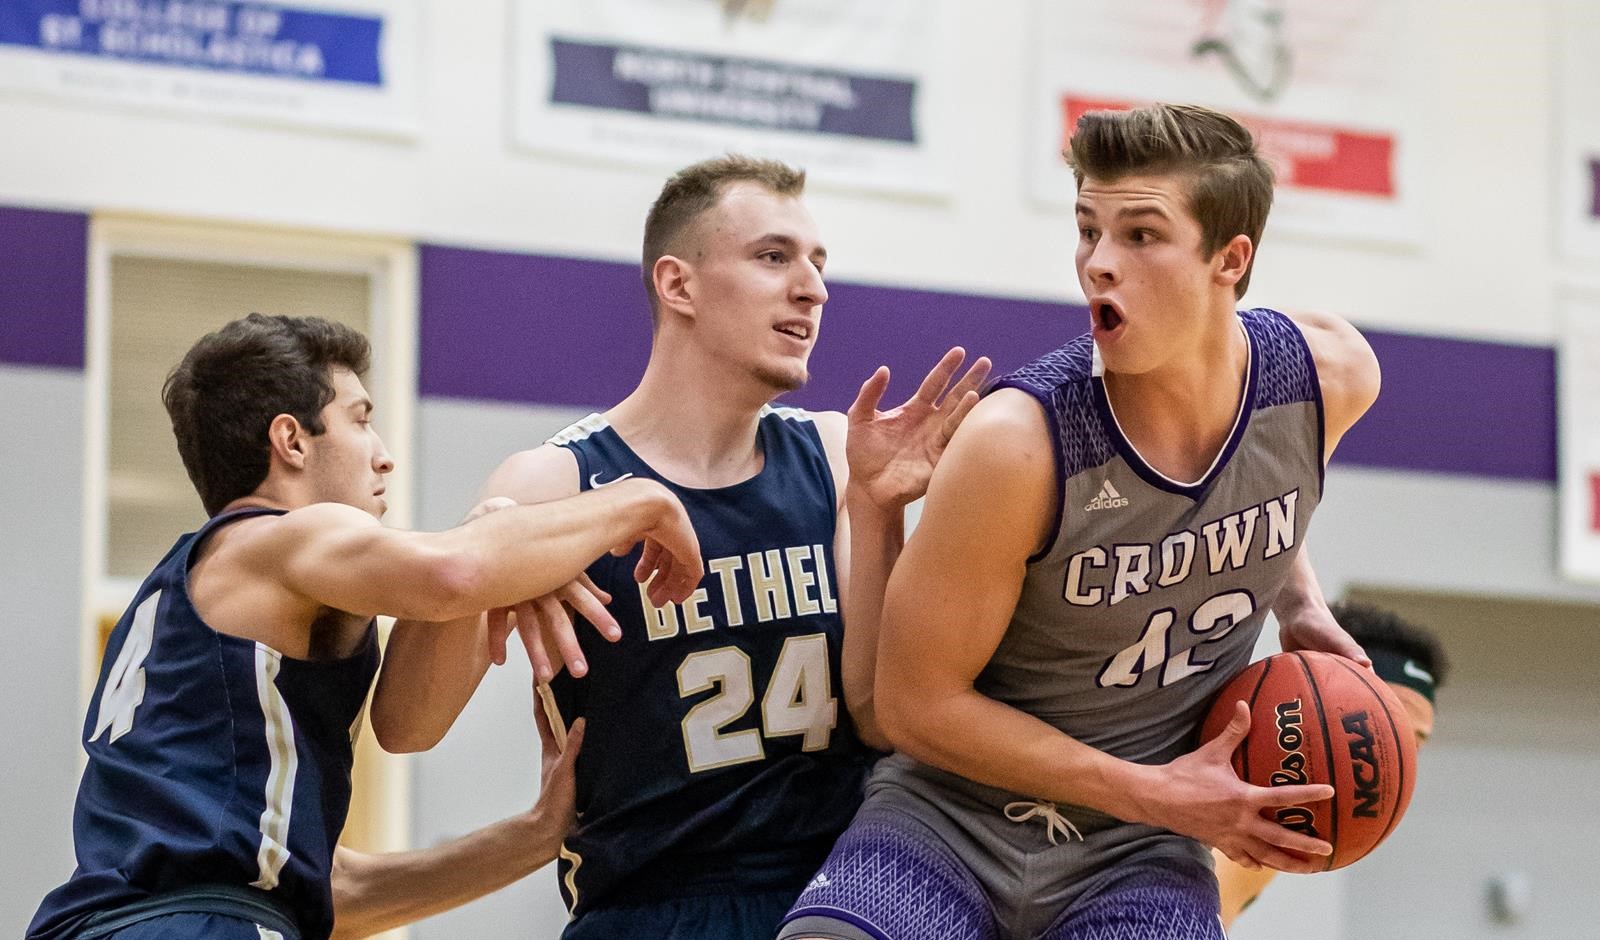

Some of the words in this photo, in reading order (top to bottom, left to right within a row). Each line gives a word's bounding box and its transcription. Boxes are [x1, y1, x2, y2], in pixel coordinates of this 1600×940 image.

[1062, 487, 1299, 607] CROWN
[1084, 496, 1129, 512] adidas
[88, 588, 163, 745] 4
[1095, 588, 1257, 689] 42
[676, 633, 838, 773] 24
[1268, 698, 1320, 838] lson
[1341, 709, 1380, 819] NCAA
